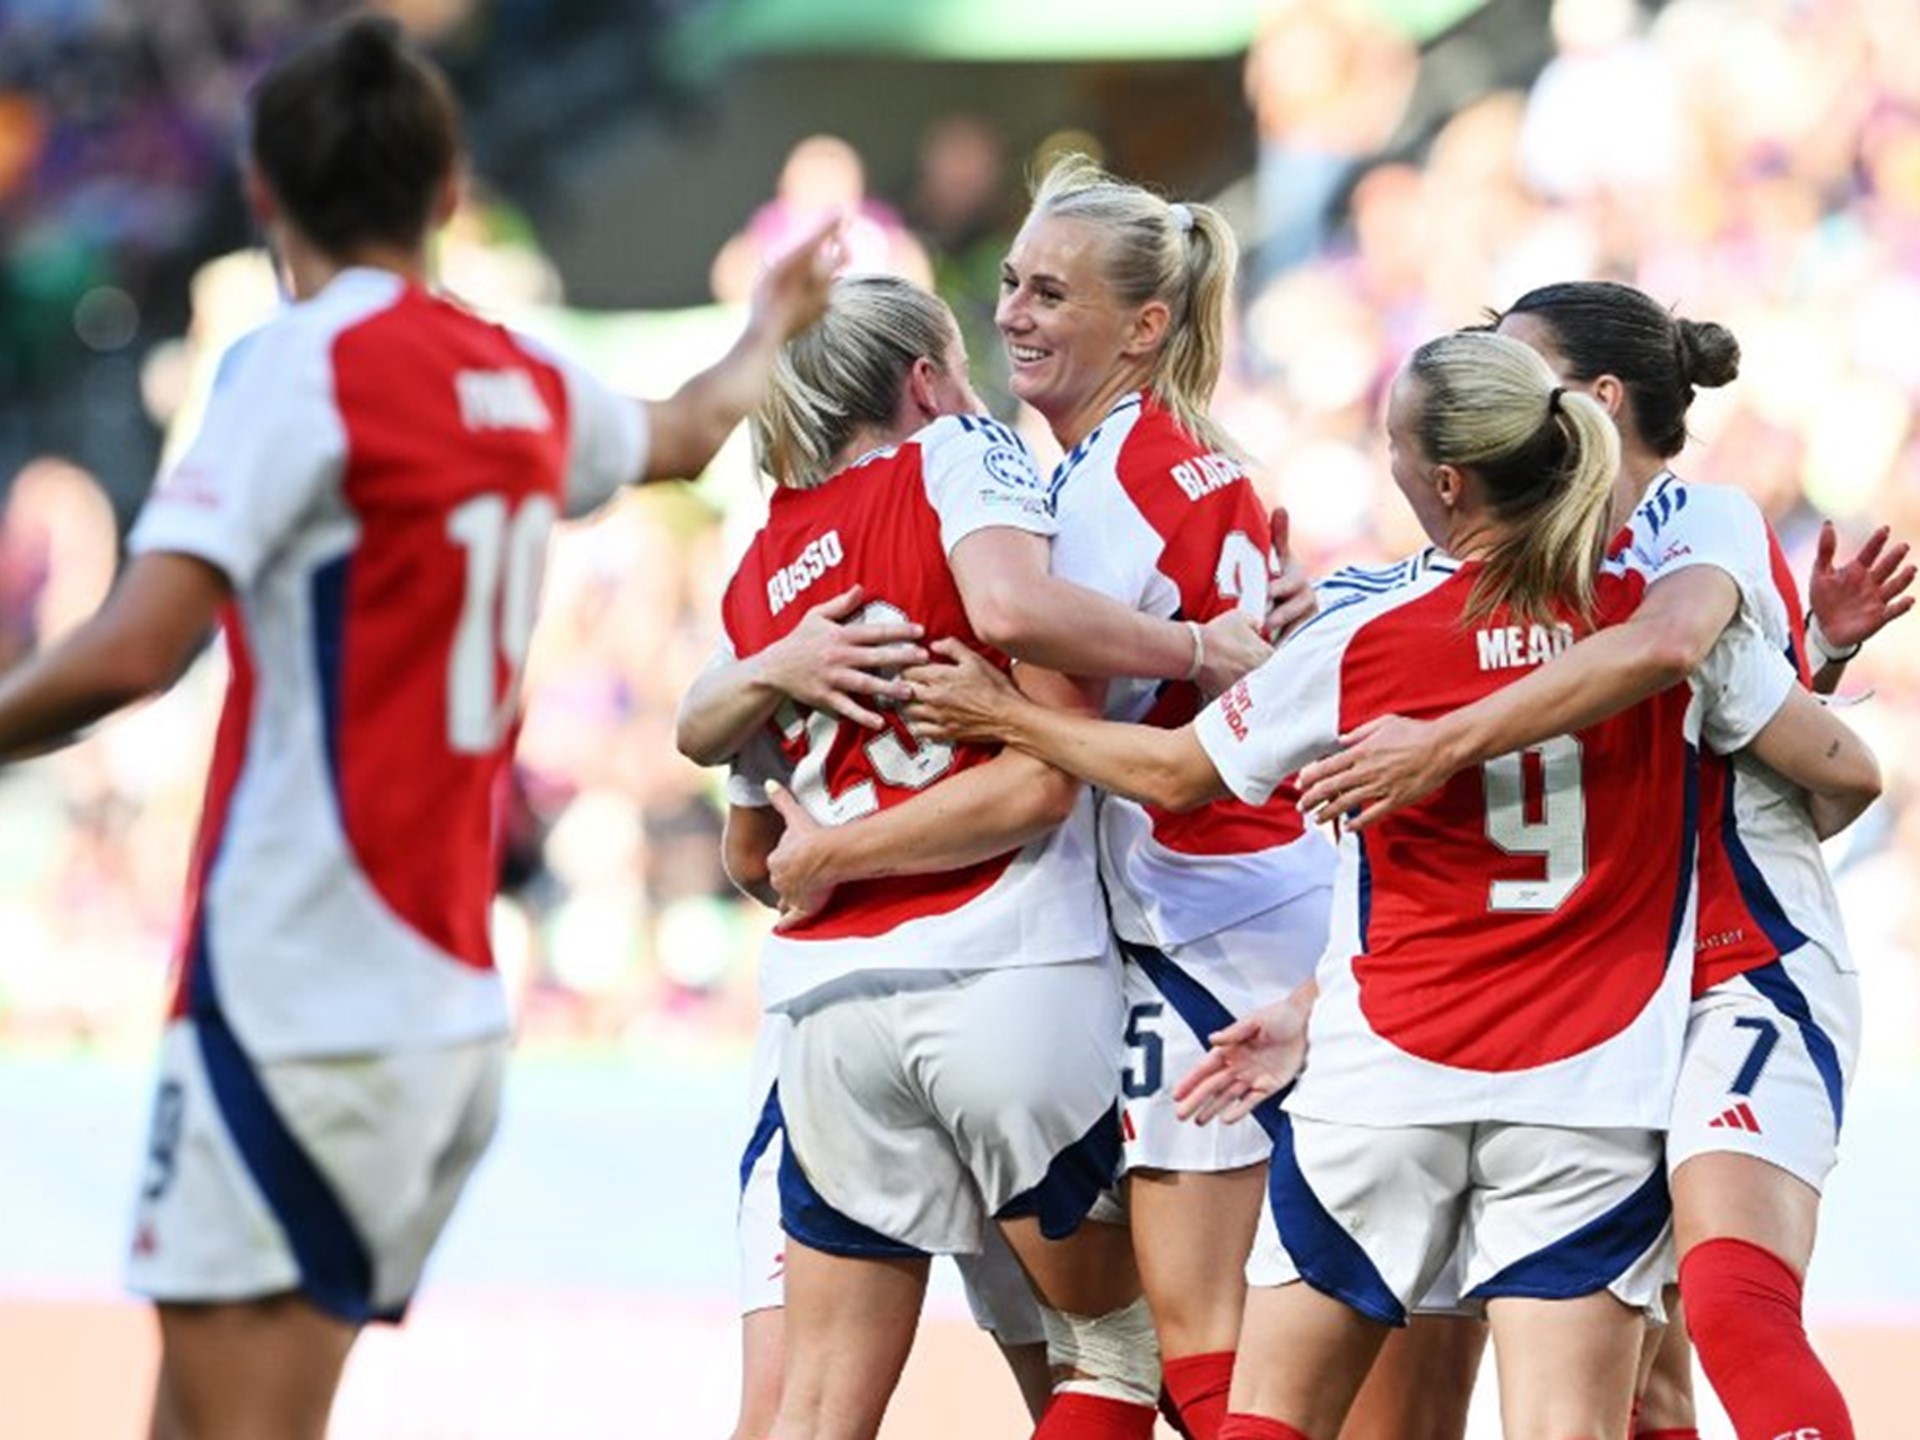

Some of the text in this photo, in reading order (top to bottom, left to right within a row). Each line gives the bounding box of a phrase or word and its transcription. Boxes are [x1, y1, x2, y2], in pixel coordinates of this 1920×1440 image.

[767, 529, 844, 617] RUSSO
[1484, 732, 1588, 914] 9
[1121, 1001, 1164, 1099] 5
[1728, 1015, 1781, 1097] 7
